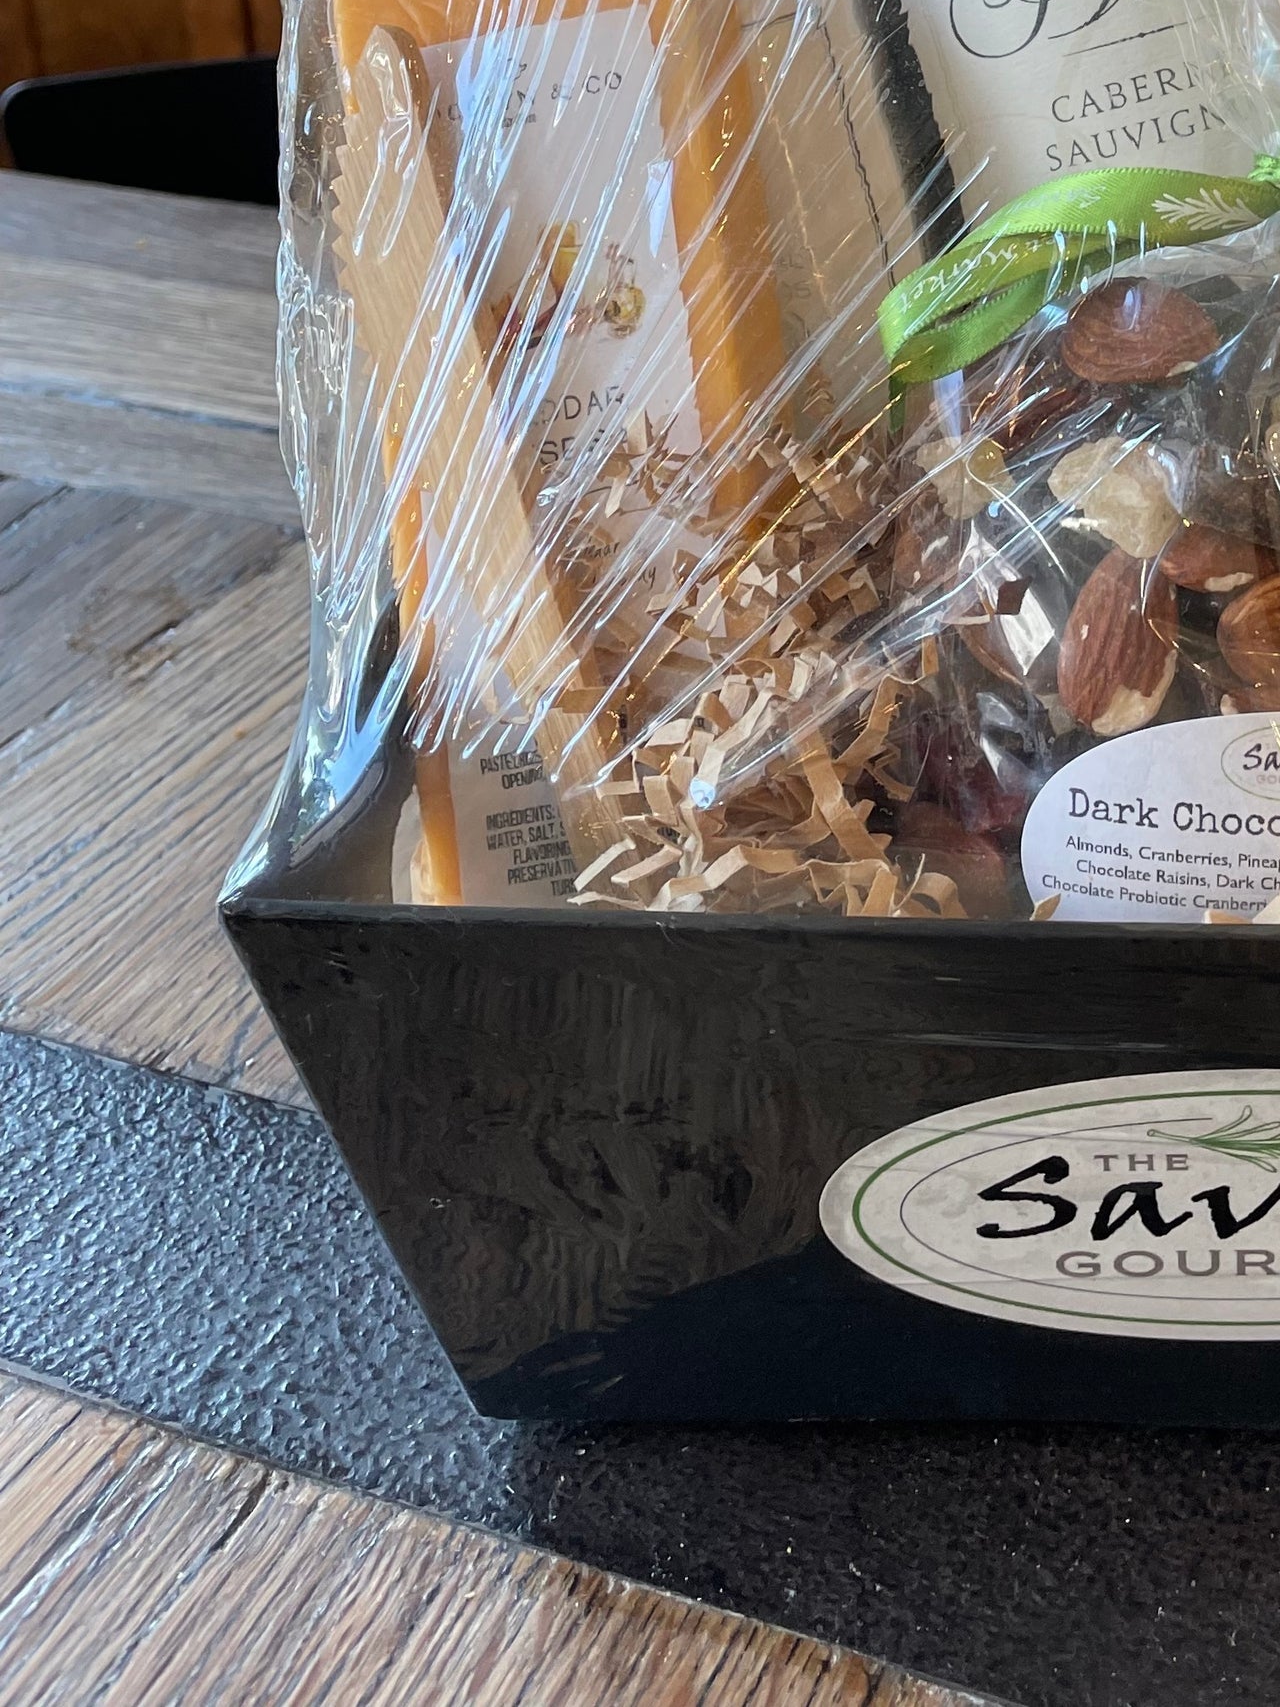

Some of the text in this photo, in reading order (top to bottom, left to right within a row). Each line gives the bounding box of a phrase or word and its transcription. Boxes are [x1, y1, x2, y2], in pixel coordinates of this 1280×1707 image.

[1068, 787, 1159, 830] Dark
[1065, 835, 1133, 860] Almonds,
[1138, 846, 1233, 869] Cranberries,
[1075, 859, 1151, 883] Chocolate
[1155, 869, 1211, 889] Raisins,
[1216, 873, 1255, 891] Dark
[1041, 874, 1115, 900] Chocolate
[1119, 886, 1188, 908] Probiotic
[1192, 894, 1268, 913] Cranberri
[1093, 1153, 1190, 1172] THE
